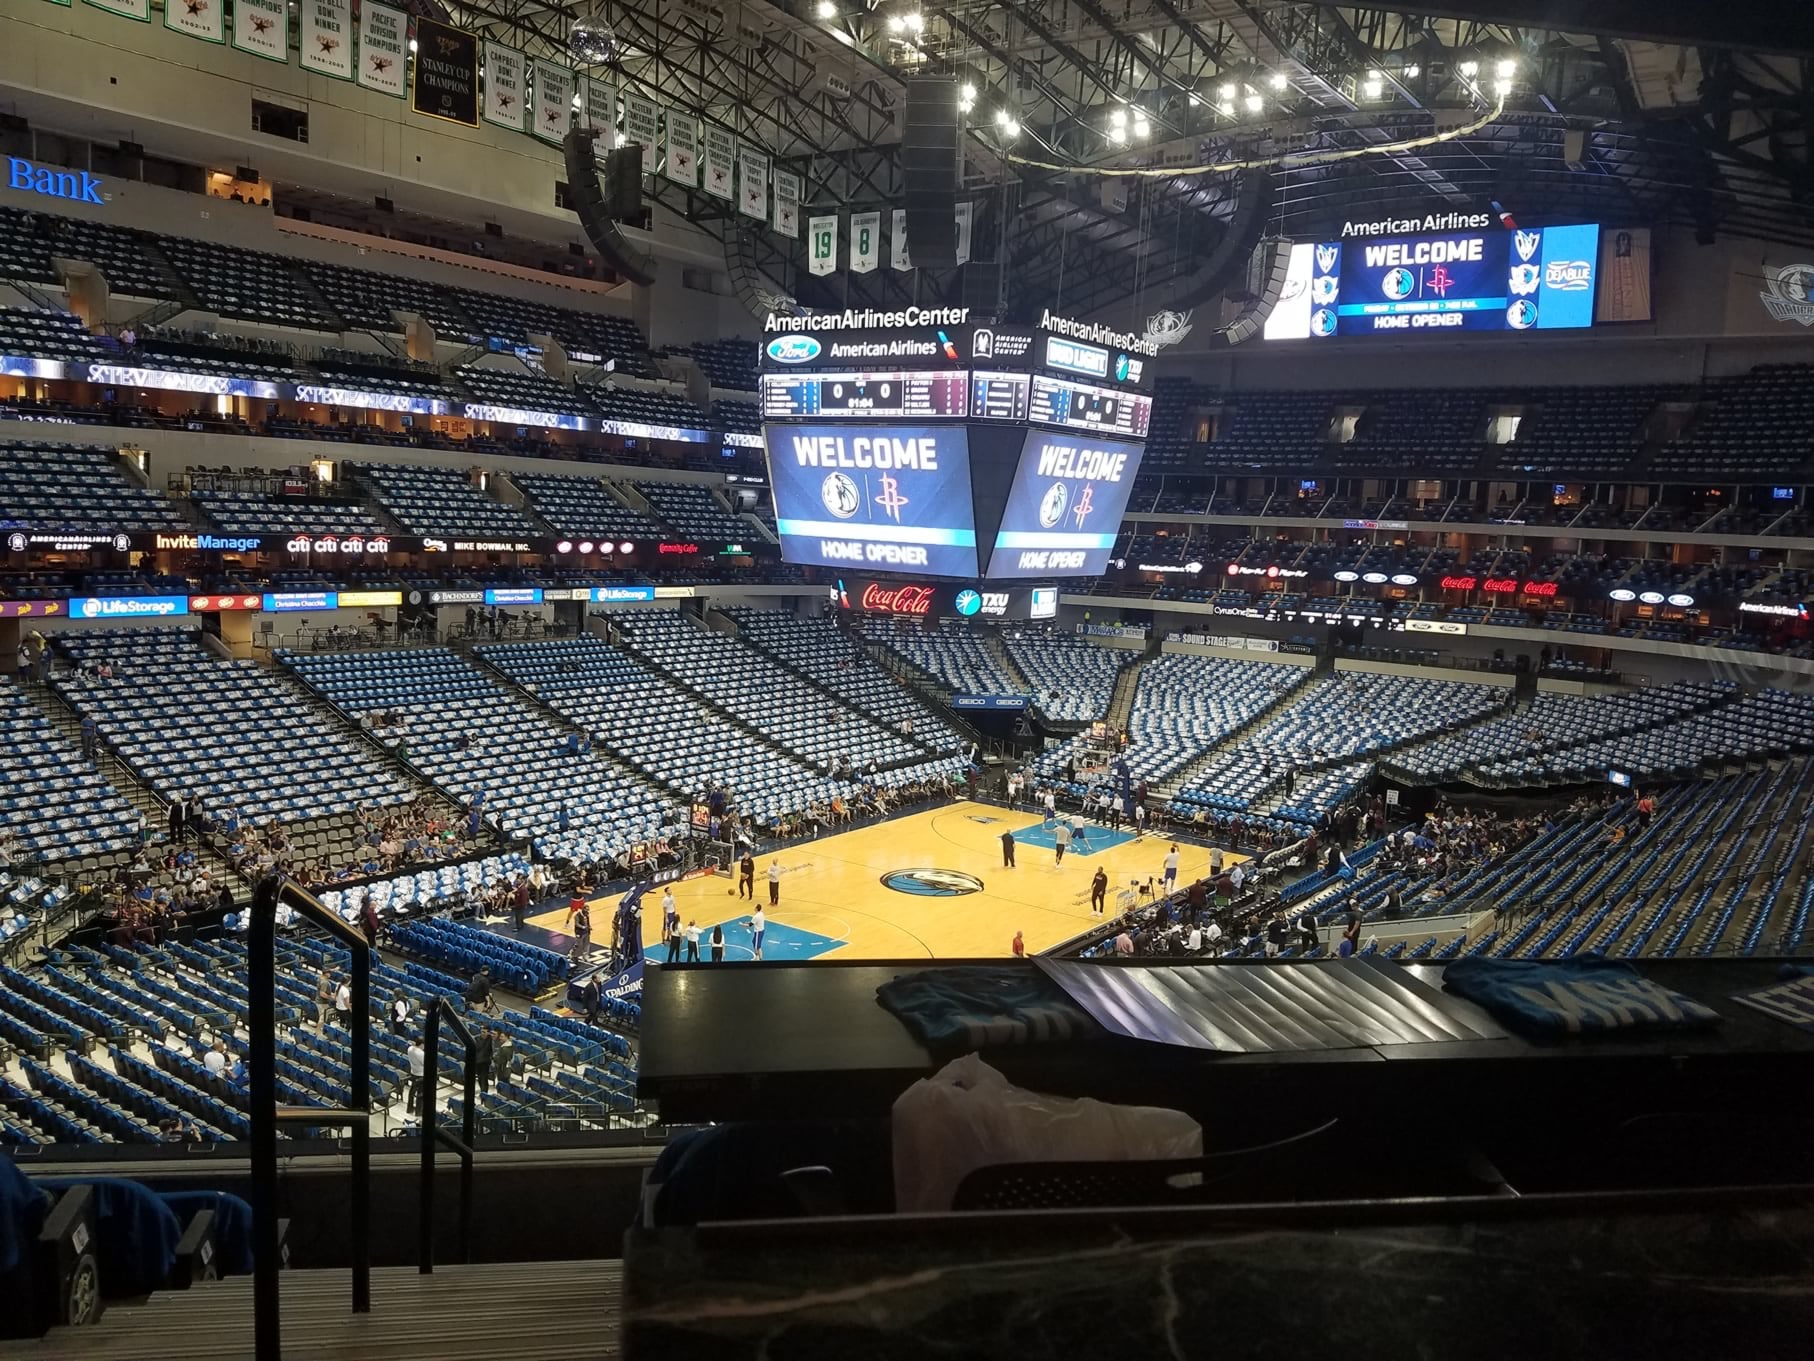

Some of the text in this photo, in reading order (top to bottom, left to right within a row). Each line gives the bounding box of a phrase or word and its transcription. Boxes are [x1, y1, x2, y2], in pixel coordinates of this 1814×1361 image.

[317, 5, 337, 20] BOWL
[371, 11, 397, 28] PACIFIC
[314, 16, 341, 33] WINNER
[369, 24, 398, 41] DIVISION
[364, 34, 401, 55] CHAMPIONS
[422, 57, 470, 81] STANLEY CUP
[490, 51, 520, 69] CAMPBELL
[498, 65, 513, 78] BOWL
[424, 73, 469, 94] CHAMPIONS
[495, 76, 516, 90] WINNER
[8, 156, 105, 205] Bank
[1341, 212, 1489, 237] American Airlines
[814, 231, 831, 259] 19
[859, 228, 870, 256] 8
[1365, 239, 1484, 267] WELCOME
[764, 307, 970, 332] AmericanAirlinesCenter
[1374, 313, 1463, 329] HOME OPENER
[995, 335, 1032, 343] AMERICAN
[1041, 309, 1159, 357] AmericanAirlinesCenter
[830, 340, 937, 358] American Airlines
[995, 342, 1029, 350] AIRLINES
[833, 383, 892, 400] 0 0
[1077, 395, 1113, 414] 0 0
[793, 437, 938, 470] WELCOME
[1037, 444, 1128, 482] WELCOME
[156, 534, 261, 551] InviteManager
[287, 534, 390, 553] citi citi citi citi
[454, 542, 474, 551] MIKE
[476, 542, 513, 552] BOWMAN,
[515, 543, 531, 551] INC.
[821, 540, 928, 566] HOME OPENER
[1018, 551, 1085, 569] HOME OPENER
[103, 599, 175, 615] LifeStorage
[862, 583, 936, 614] Coca-Cola
[981, 593, 1009, 607] TXU
[981, 606, 1007, 615] energy
[1214, 606, 1248, 616] CyrusOne
[1740, 602, 1799, 616] American Airlines
[1183, 633, 1205, 645] SOUND
[1206, 634, 1228, 648] STAGE
[606, 977, 645, 998] SPALDING
